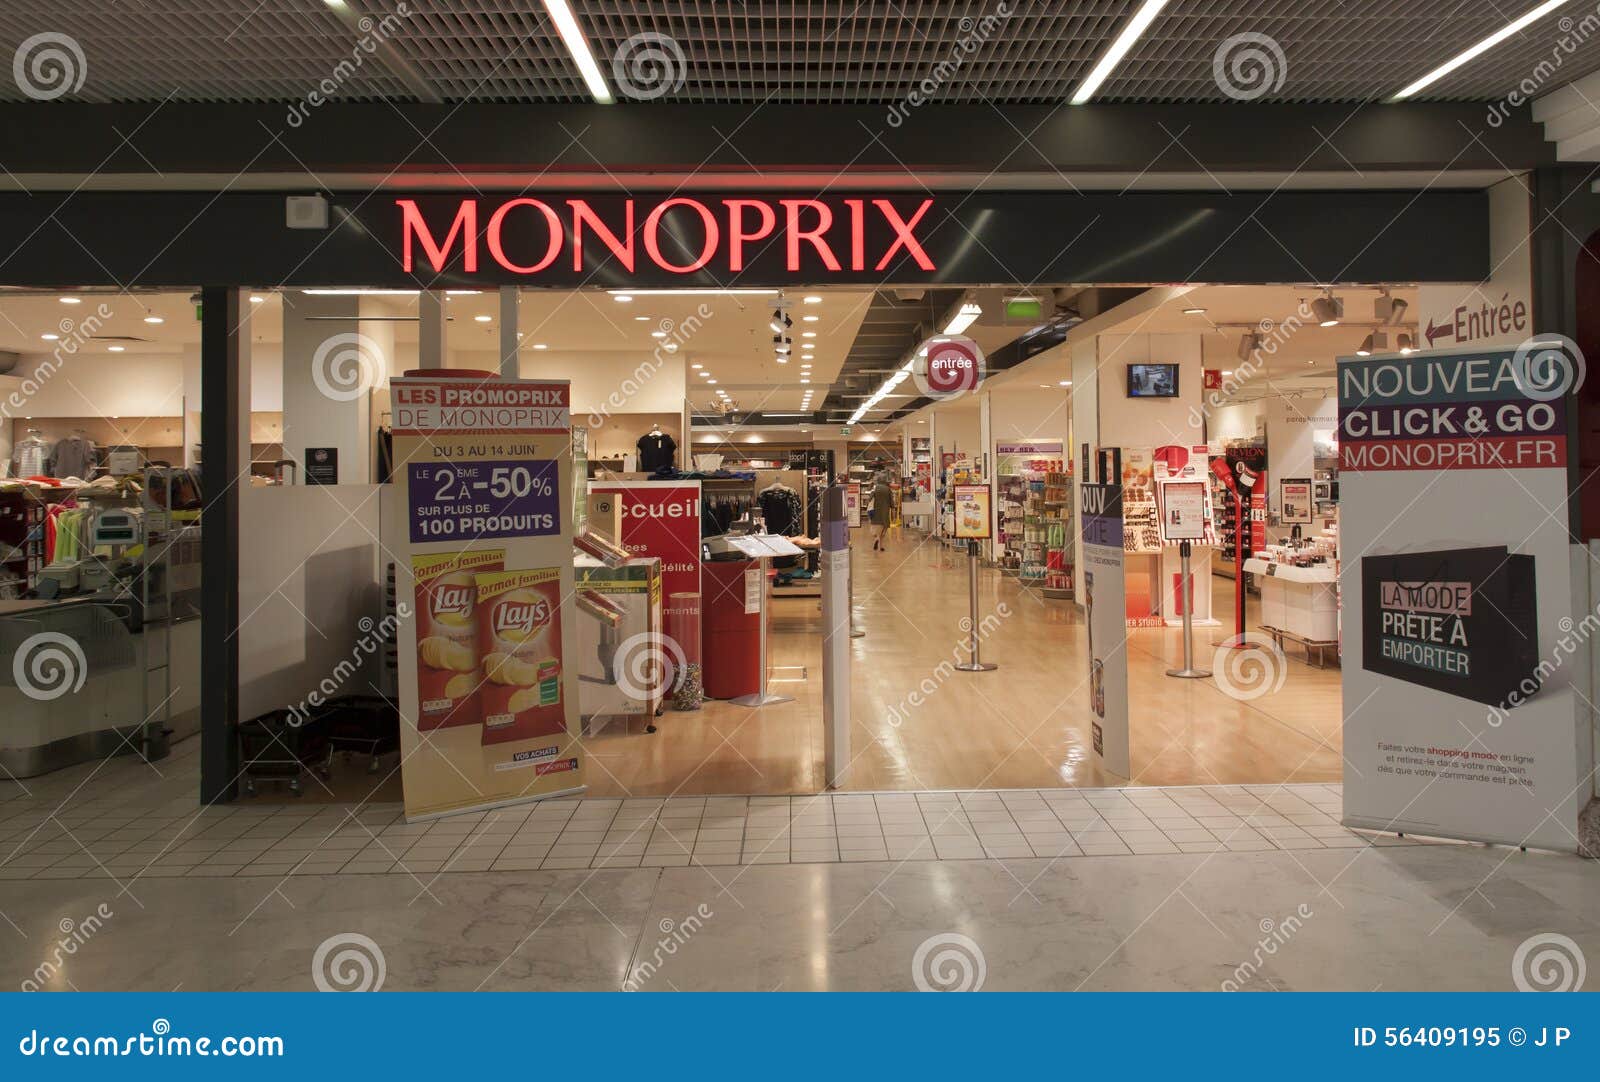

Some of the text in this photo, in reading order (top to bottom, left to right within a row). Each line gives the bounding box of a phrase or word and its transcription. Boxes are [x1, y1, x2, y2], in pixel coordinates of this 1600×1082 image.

[396, 198, 936, 274] MONOPRIX
[1455, 293, 1526, 343] Entrée
[931, 357, 973, 369] entrée
[1344, 356, 1555, 399] NOUVEAU
[398, 389, 563, 405] LES PROMOPRIX
[399, 409, 563, 427] DE MONOPRIX
[433, 445, 535, 457] DU 3 AU 14 JUIN
[1345, 441, 1557, 467] MONOPRIX.FR
[416, 470, 429, 479] LE
[473, 467, 552, 498] -50%
[418, 504, 490, 516] SUR PLUS DE
[1082, 486, 1106, 514] OUV
[419, 514, 553, 535] 100 PRODUITS
[660, 562, 694, 572] délité
[434, 585, 473, 617] Lay
[1382, 586, 1468, 611] LA MODE
[497, 601, 546, 632] Lay's
[1382, 610, 1468, 647] PRÊTE À
[1382, 639, 1470, 675] EMPORTER
[1377, 742, 1535, 766] Faites votre shopping mode en ligne
[1396, 756, 1435, 766] retirez-le
[1461, 762, 1484, 770] votre
[1486, 764, 1526, 775] magasin
[1395, 767, 1412, 777] que
[1414, 768, 1436, 778] votre
[1439, 772, 1490, 783] commande
[1492, 776, 1506, 785] est
